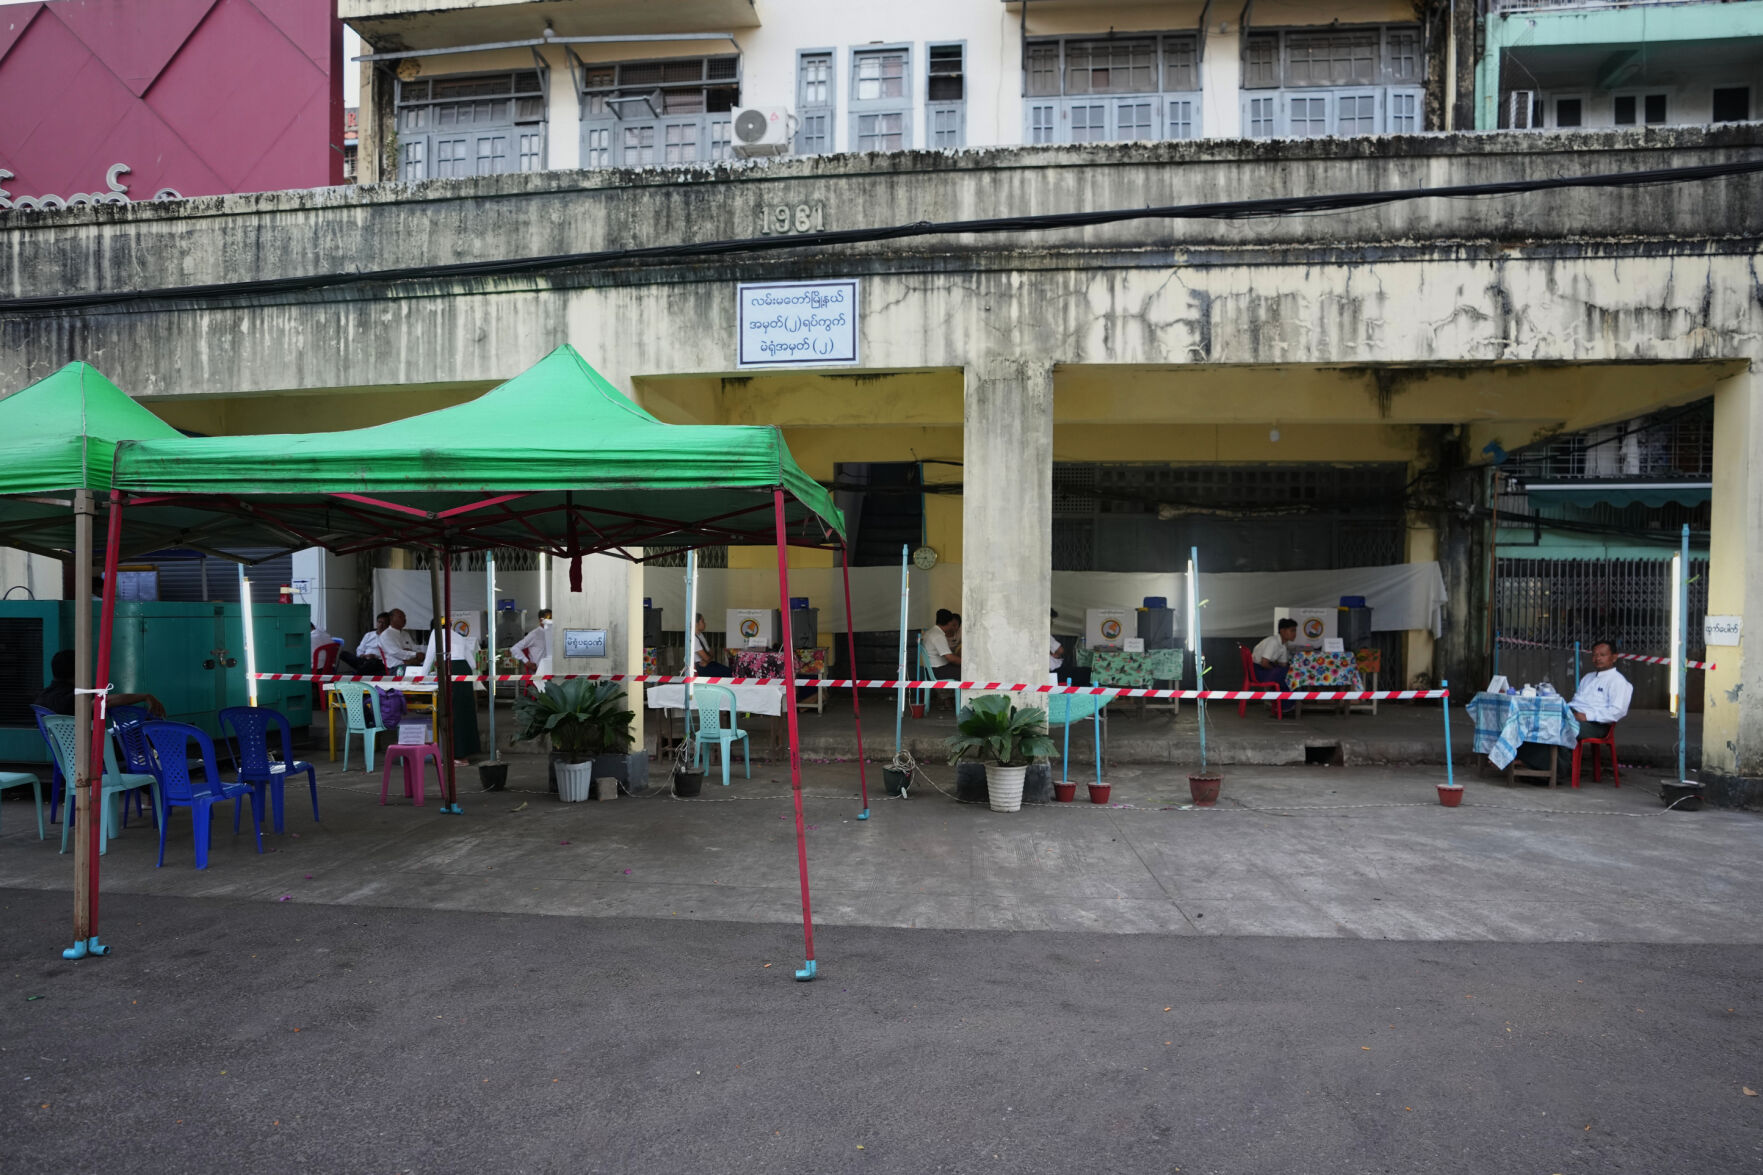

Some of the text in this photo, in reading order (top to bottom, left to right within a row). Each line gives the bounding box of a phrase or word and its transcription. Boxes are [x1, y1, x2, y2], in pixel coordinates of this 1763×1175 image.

[761, 203, 824, 233] 1961
[751, 290, 844, 309] လမ်းမတော်မြို့နယ်
